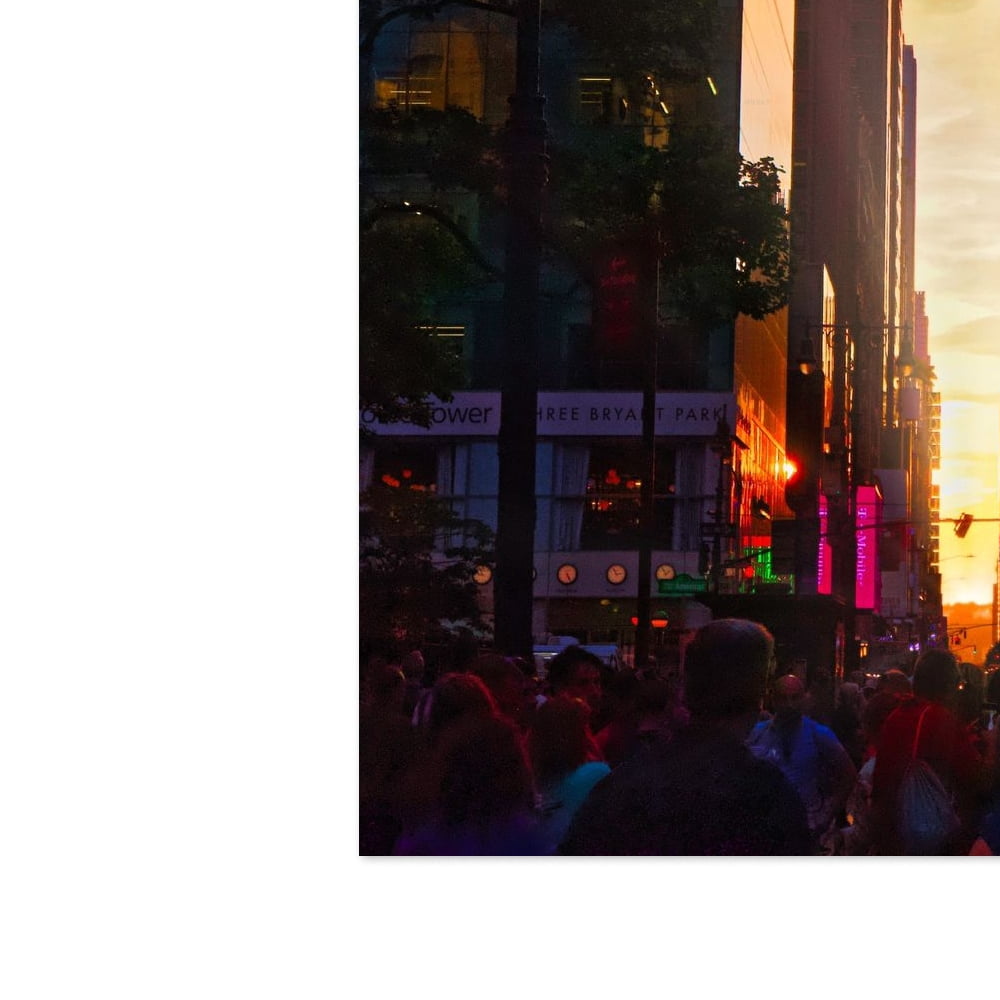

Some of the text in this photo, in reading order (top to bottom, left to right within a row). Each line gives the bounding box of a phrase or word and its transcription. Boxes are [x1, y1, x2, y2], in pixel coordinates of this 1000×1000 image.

[535, 408, 722, 421] HREE BRYAT PARK
